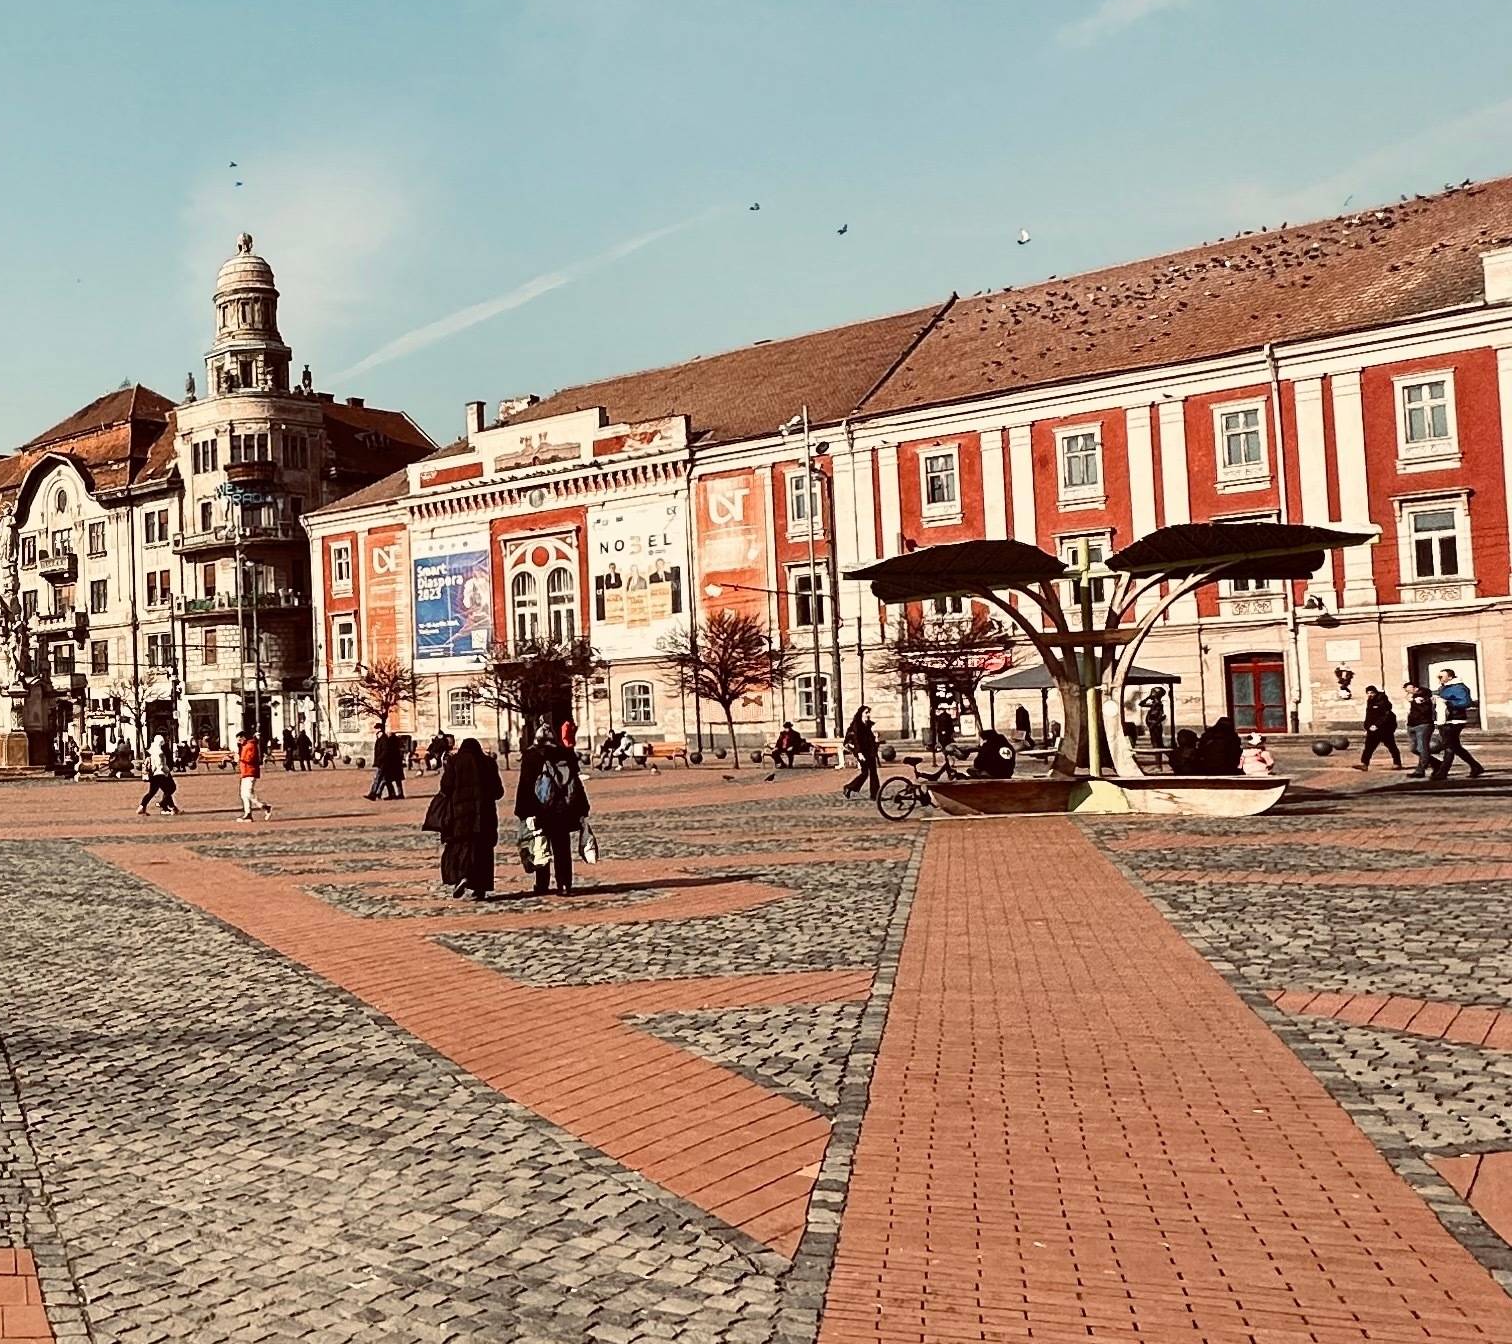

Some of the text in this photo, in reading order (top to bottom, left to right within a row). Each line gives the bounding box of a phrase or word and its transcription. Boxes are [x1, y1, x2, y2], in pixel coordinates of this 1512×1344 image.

[417, 562, 448, 577] Smart
[417, 574, 464, 590] Diaspora
[417, 587, 442, 602] 2023
